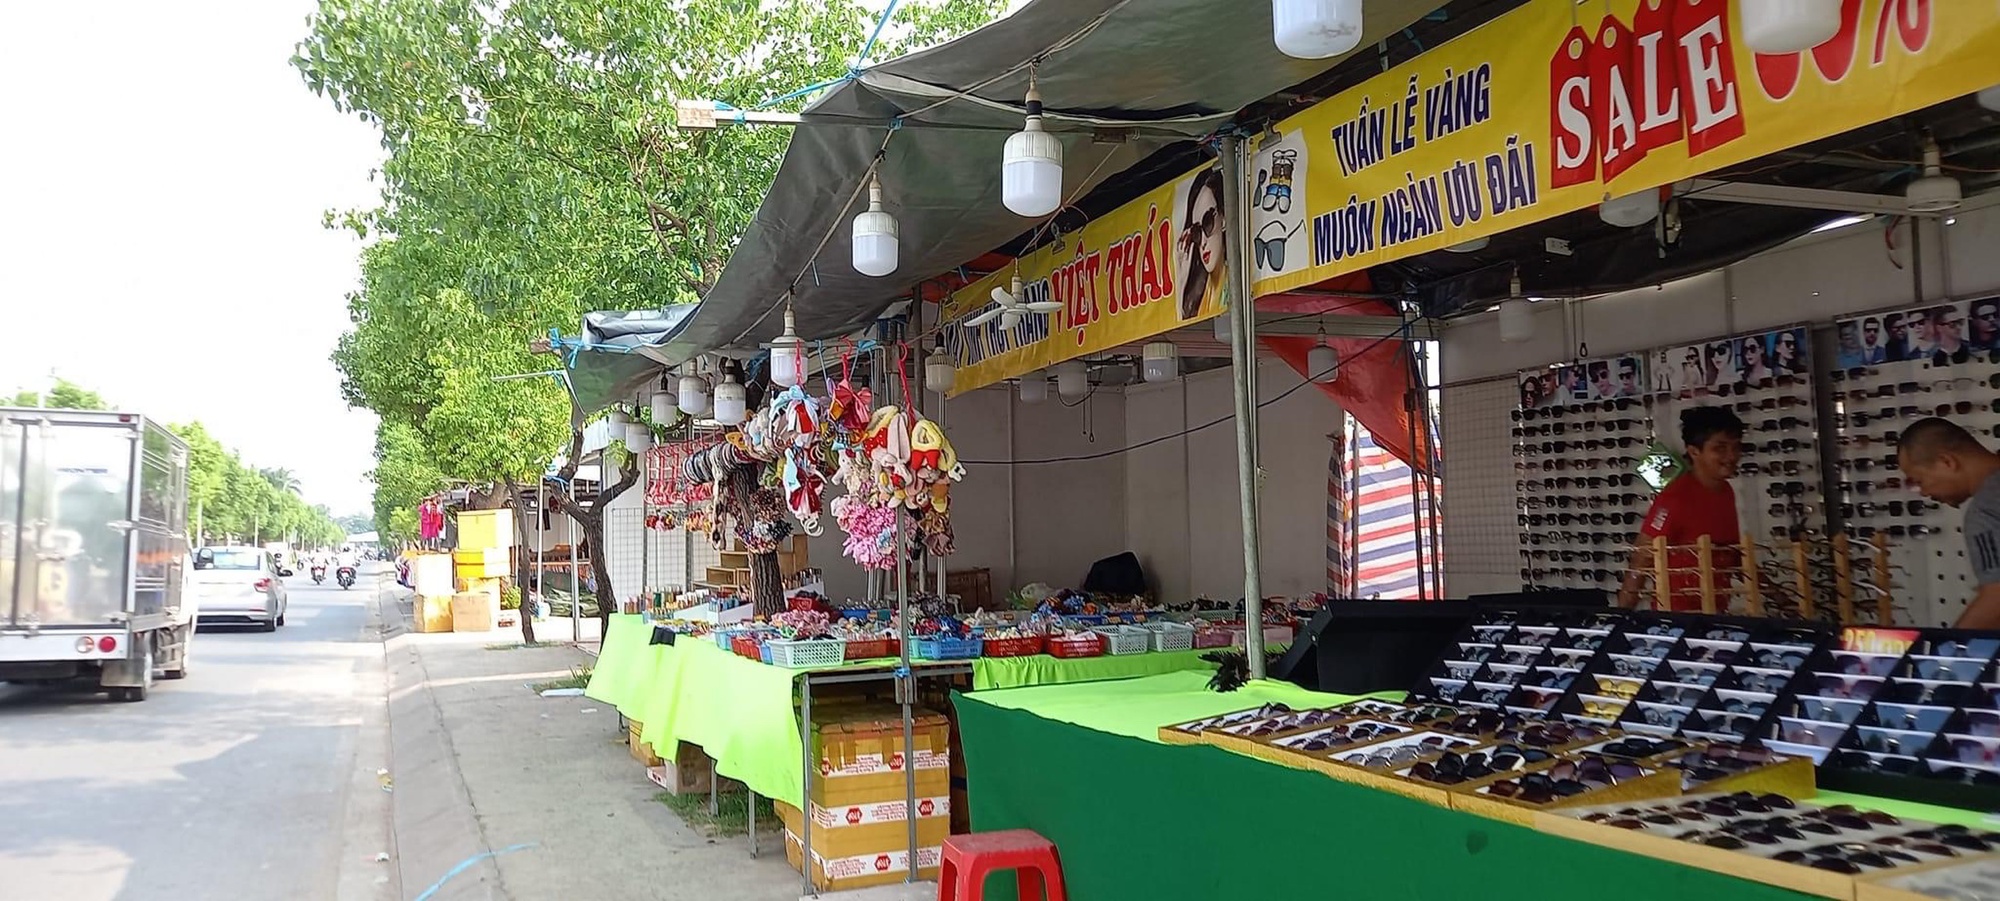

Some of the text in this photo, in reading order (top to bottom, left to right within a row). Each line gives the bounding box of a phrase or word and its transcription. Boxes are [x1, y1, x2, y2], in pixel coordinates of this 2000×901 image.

[1332, 63, 1491, 177] TUẦN LỄ VÀNG
[1556, 15, 1738, 169] SALE
[1313, 135, 1537, 266] MUÔN NGÀN ƯU ĐÃI
[1052, 238, 1100, 347] VIỆT
[1106, 204, 1173, 315] THÁI
